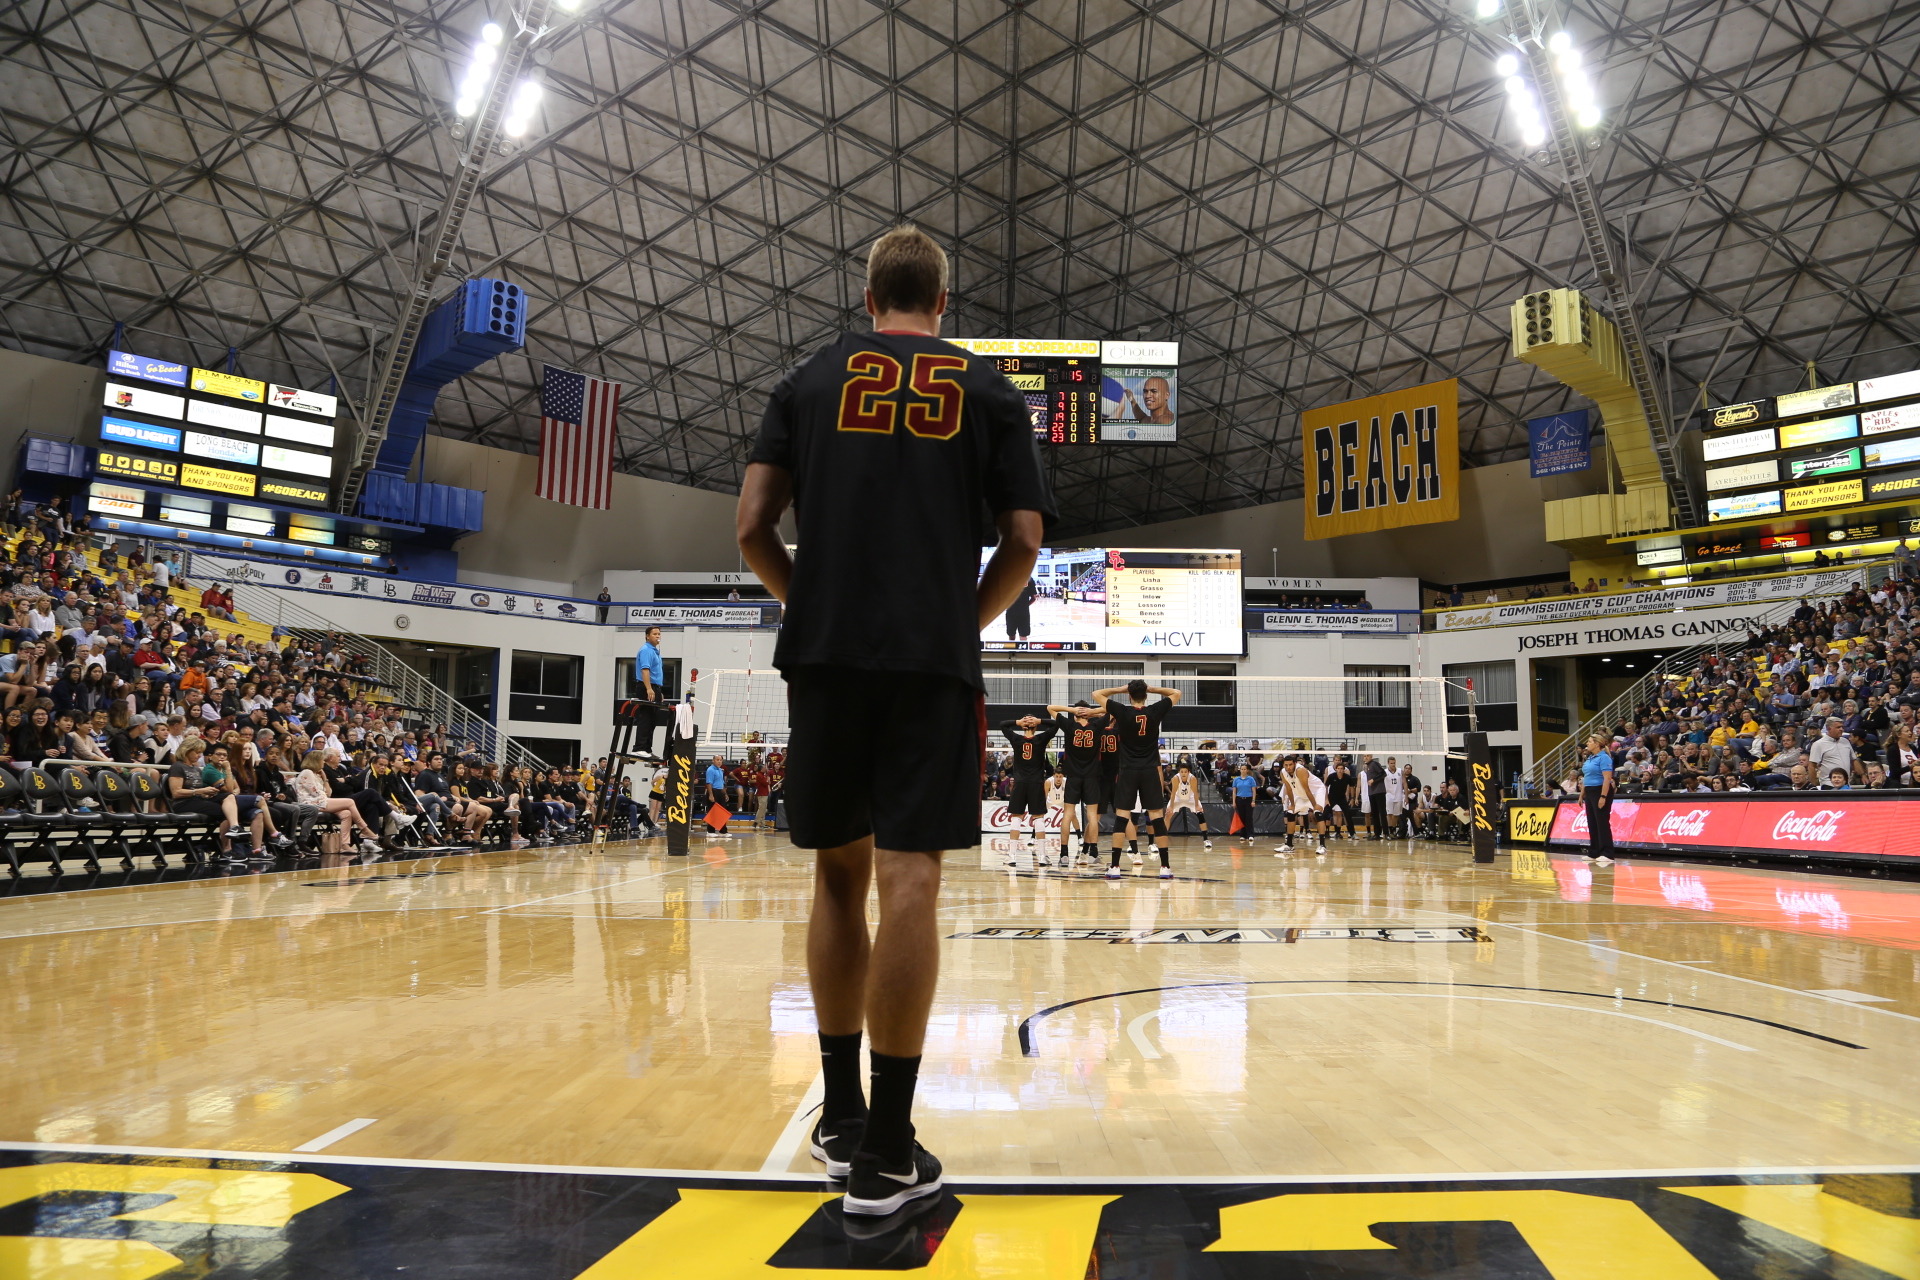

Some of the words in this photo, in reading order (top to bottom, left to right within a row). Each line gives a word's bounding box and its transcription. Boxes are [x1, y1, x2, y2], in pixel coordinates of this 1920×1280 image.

[973, 341, 1015, 353] MOORE
[1018, 342, 1098, 354] SCOREBOARD
[197, 369, 261, 387] TIMMONS
[1071, 370, 1083, 381] 15
[837, 351, 968, 440] 25
[1718, 407, 1754, 424] Legends
[1874, 417, 1891, 427] RIB
[105, 423, 137, 437] BUD
[137, 428, 177, 445] LIGHT
[196, 434, 219, 448] LONG
[221, 438, 249, 454] BEACH
[1313, 404, 1442, 518] BEACH
[182, 466, 212, 479] THANK
[215, 471, 231, 481] YOU
[233, 474, 256, 484] FANS
[185, 477, 204, 485] AND
[206, 479, 250, 493] SPONSORS
[262, 483, 327, 502] #GOBEACH
[1785, 488, 1815, 499] THANK
[1818, 485, 1834, 494] YOU
[1837, 482, 1861, 491] FANS
[1789, 499, 1809, 508] AND
[1811, 493, 1858, 505] SPONSORS
[1697, 546, 1710, 556] Go
[1713, 543, 1742, 554] Beach
[250, 568, 265, 580] POLY
[713, 574, 742, 582] MEN
[1133, 568, 1156, 576] PLAYERS
[319, 583, 334, 591] CSUN
[413, 584, 432, 598] BIG
[431, 586, 457, 600] WEST
[1268, 579, 1323, 588] WOMEN
[1499, 597, 1601, 618] COMMISSIONER'S
[1607, 595, 1632, 607] CUP
[1635, 587, 1715, 605] CHAMPIONS
[1535, 613, 1549, 621] THE
[1550, 611, 1569, 619] BEST
[1569, 608, 1600, 618] OVERALL
[1601, 605, 1636, 616] ATHLETIC
[1638, 601, 1675, 612] PROGRAM
[631, 609, 667, 618] GLENN
[668, 609, 679, 618] E.
[680, 609, 723, 618] THOMAS
[1266, 615, 1301, 624] GLENN
[1303, 615, 1314, 624] E.
[1315, 615, 1359, 625] THOMAS
[1444, 610, 1493, 628] Beach
[1154, 631, 1206, 647] HCVT
[1517, 632, 1579, 652] JOSEPH
[1584, 624, 1665, 642] THOMAS
[1671, 615, 1760, 635] GANNON
[1135, 714, 1148, 737] 7
[1073, 729, 1094, 748] 22
[1100, 734, 1118, 753] 19
[1022, 742, 1033, 760] 9
[667, 754, 692, 825] Beach
[1472, 762, 1494, 832] Beach
[1515, 810, 1528, 837] Go
